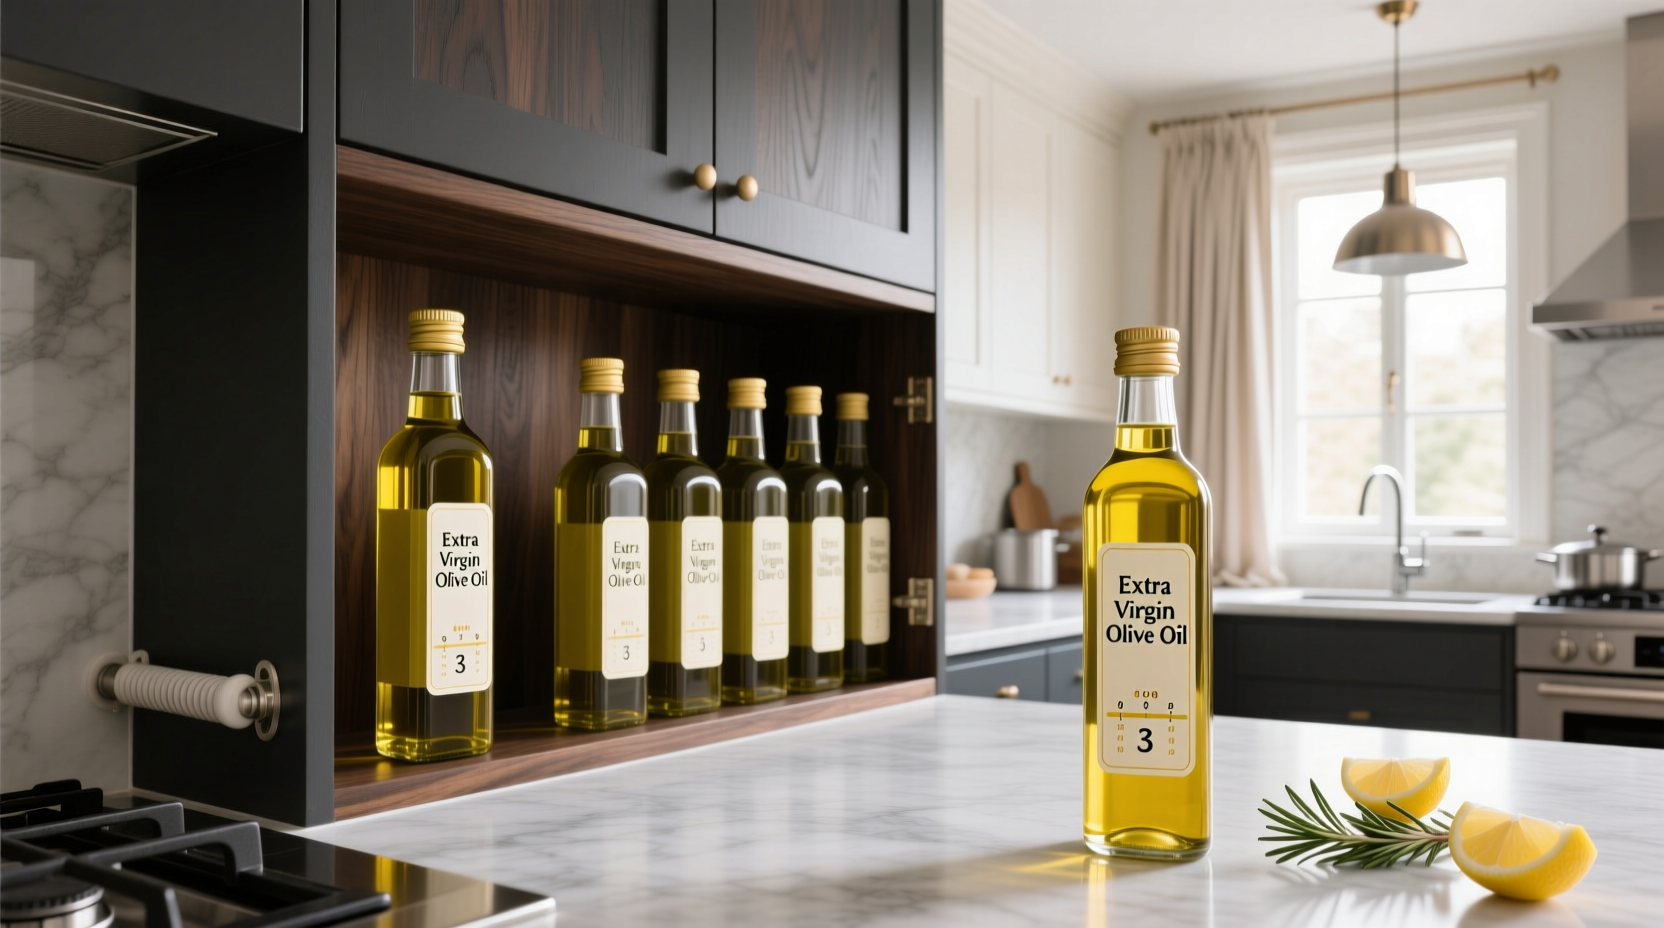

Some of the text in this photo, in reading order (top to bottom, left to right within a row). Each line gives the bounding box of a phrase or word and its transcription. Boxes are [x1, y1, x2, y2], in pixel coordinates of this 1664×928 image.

[442, 531, 479, 547] Extra
[439, 551, 480, 571] Virgin
[435, 570, 488, 588] Olive Oil
[1119, 575, 1172, 595] Extra
[1114, 600, 1175, 625] Virgin
[1106, 623, 1188, 645] Olive Oil
[622, 645, 631, 661] 3
[455, 654, 466, 674] 3
[1136, 727, 1154, 754] 3
